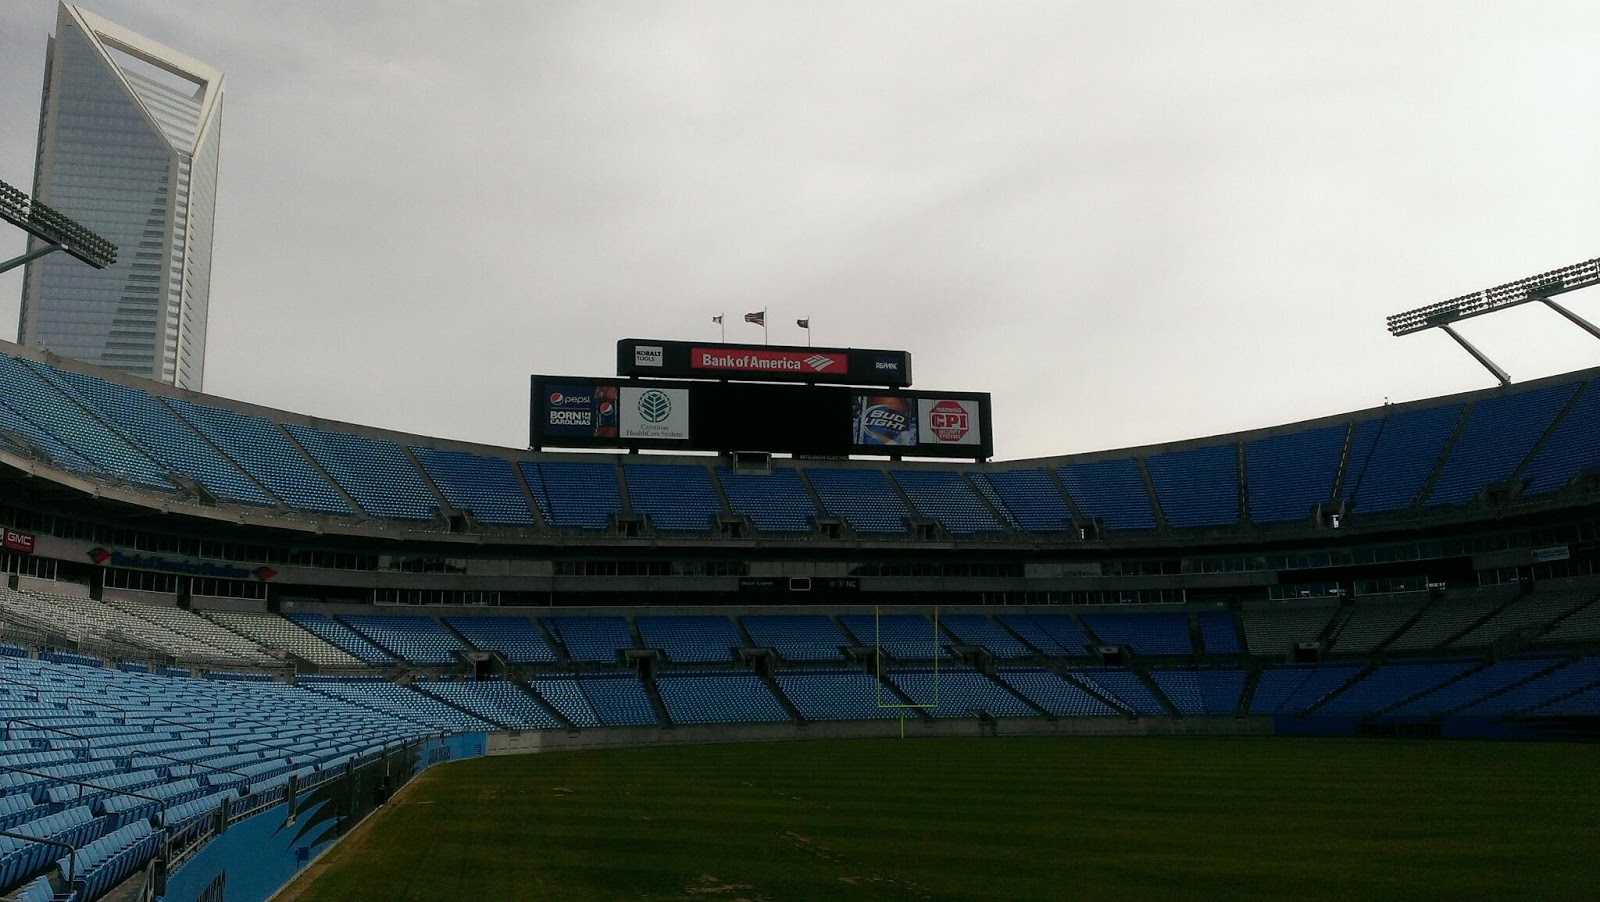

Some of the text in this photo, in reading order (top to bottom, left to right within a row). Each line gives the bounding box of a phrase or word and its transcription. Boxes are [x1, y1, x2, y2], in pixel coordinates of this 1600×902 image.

[703, 353, 801, 370] Bank of America
[564, 395, 591, 408] pepsi
[550, 411, 581, 421] BORN
[870, 409, 905, 423] BUD
[932, 414, 967, 428] CPI
[864, 417, 906, 431] LIGHT
[7, 532, 32, 546] GMC
